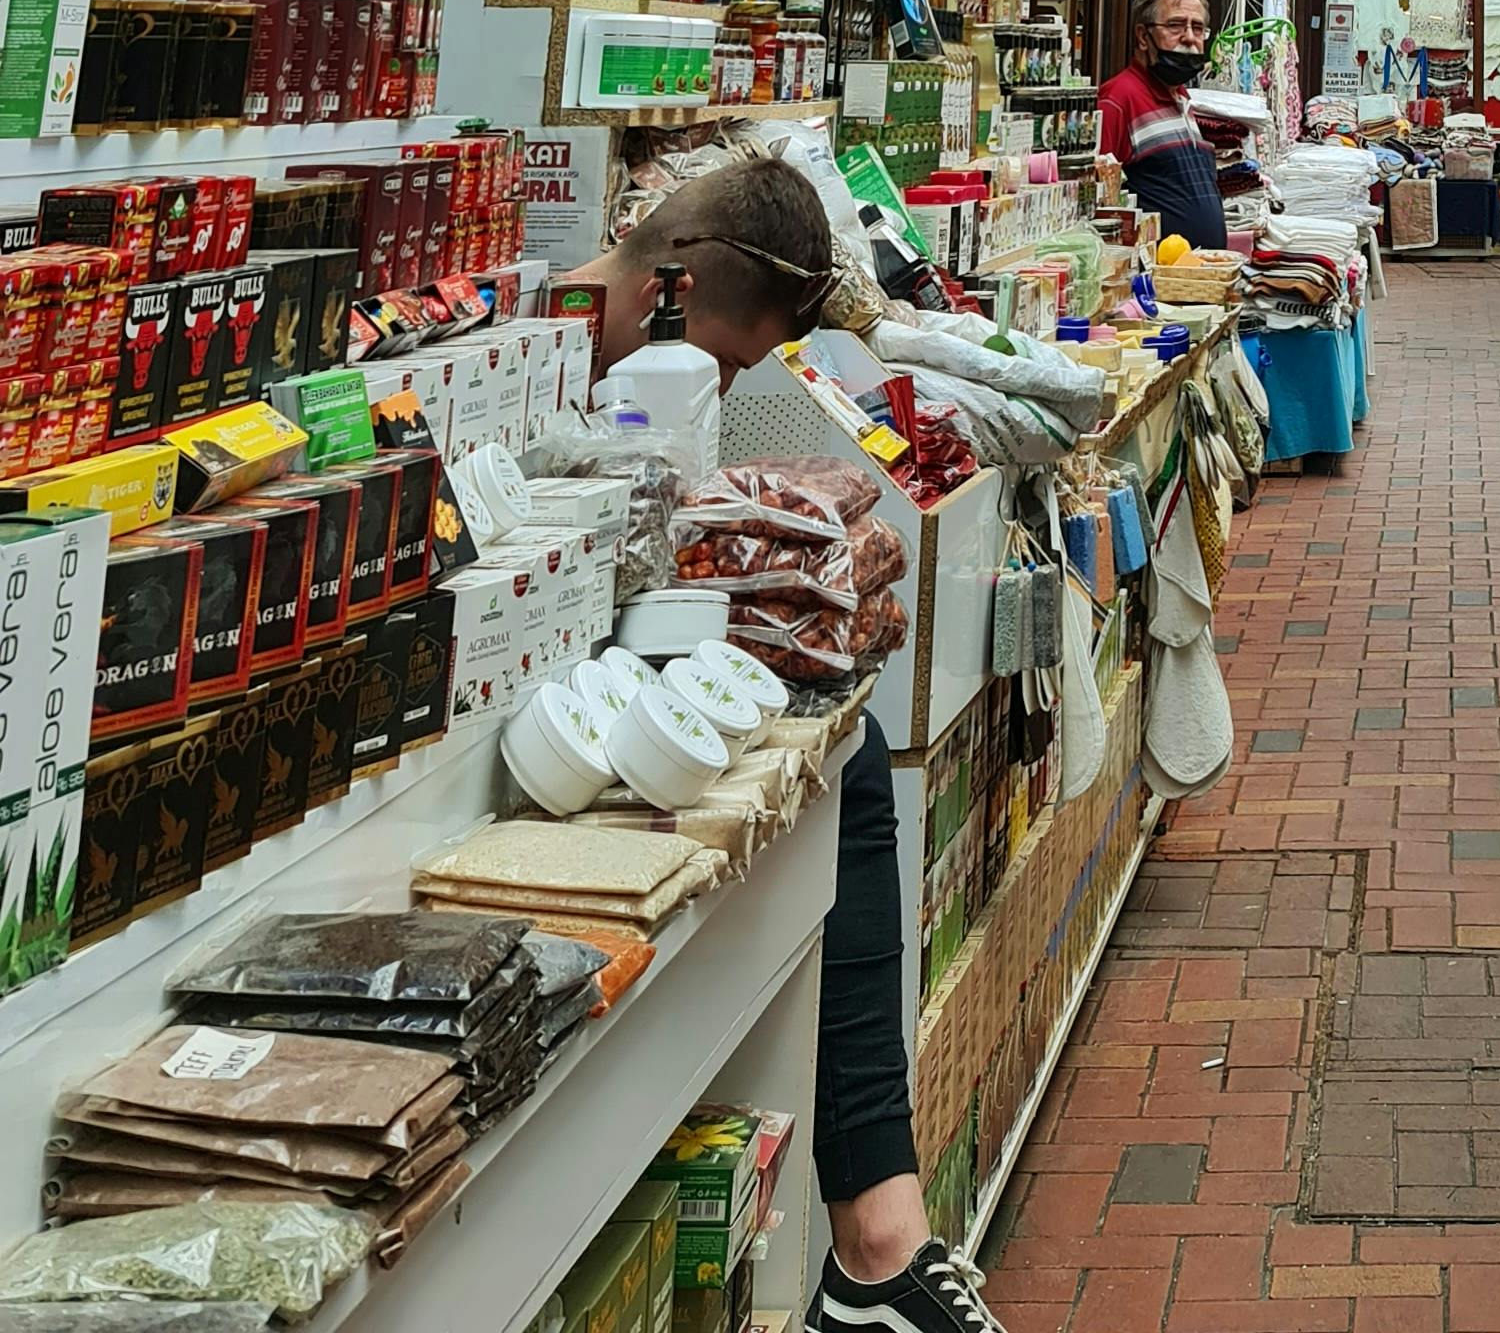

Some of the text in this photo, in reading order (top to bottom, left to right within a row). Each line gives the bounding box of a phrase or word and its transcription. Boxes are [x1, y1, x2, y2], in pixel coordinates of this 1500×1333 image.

[191, 284, 225, 307] BULLS
[233, 275, 265, 299] BULLS
[133, 293, 169, 318] BULLS
[107, 481, 142, 501] TIGER
[35, 548, 78, 793] aloe vera
